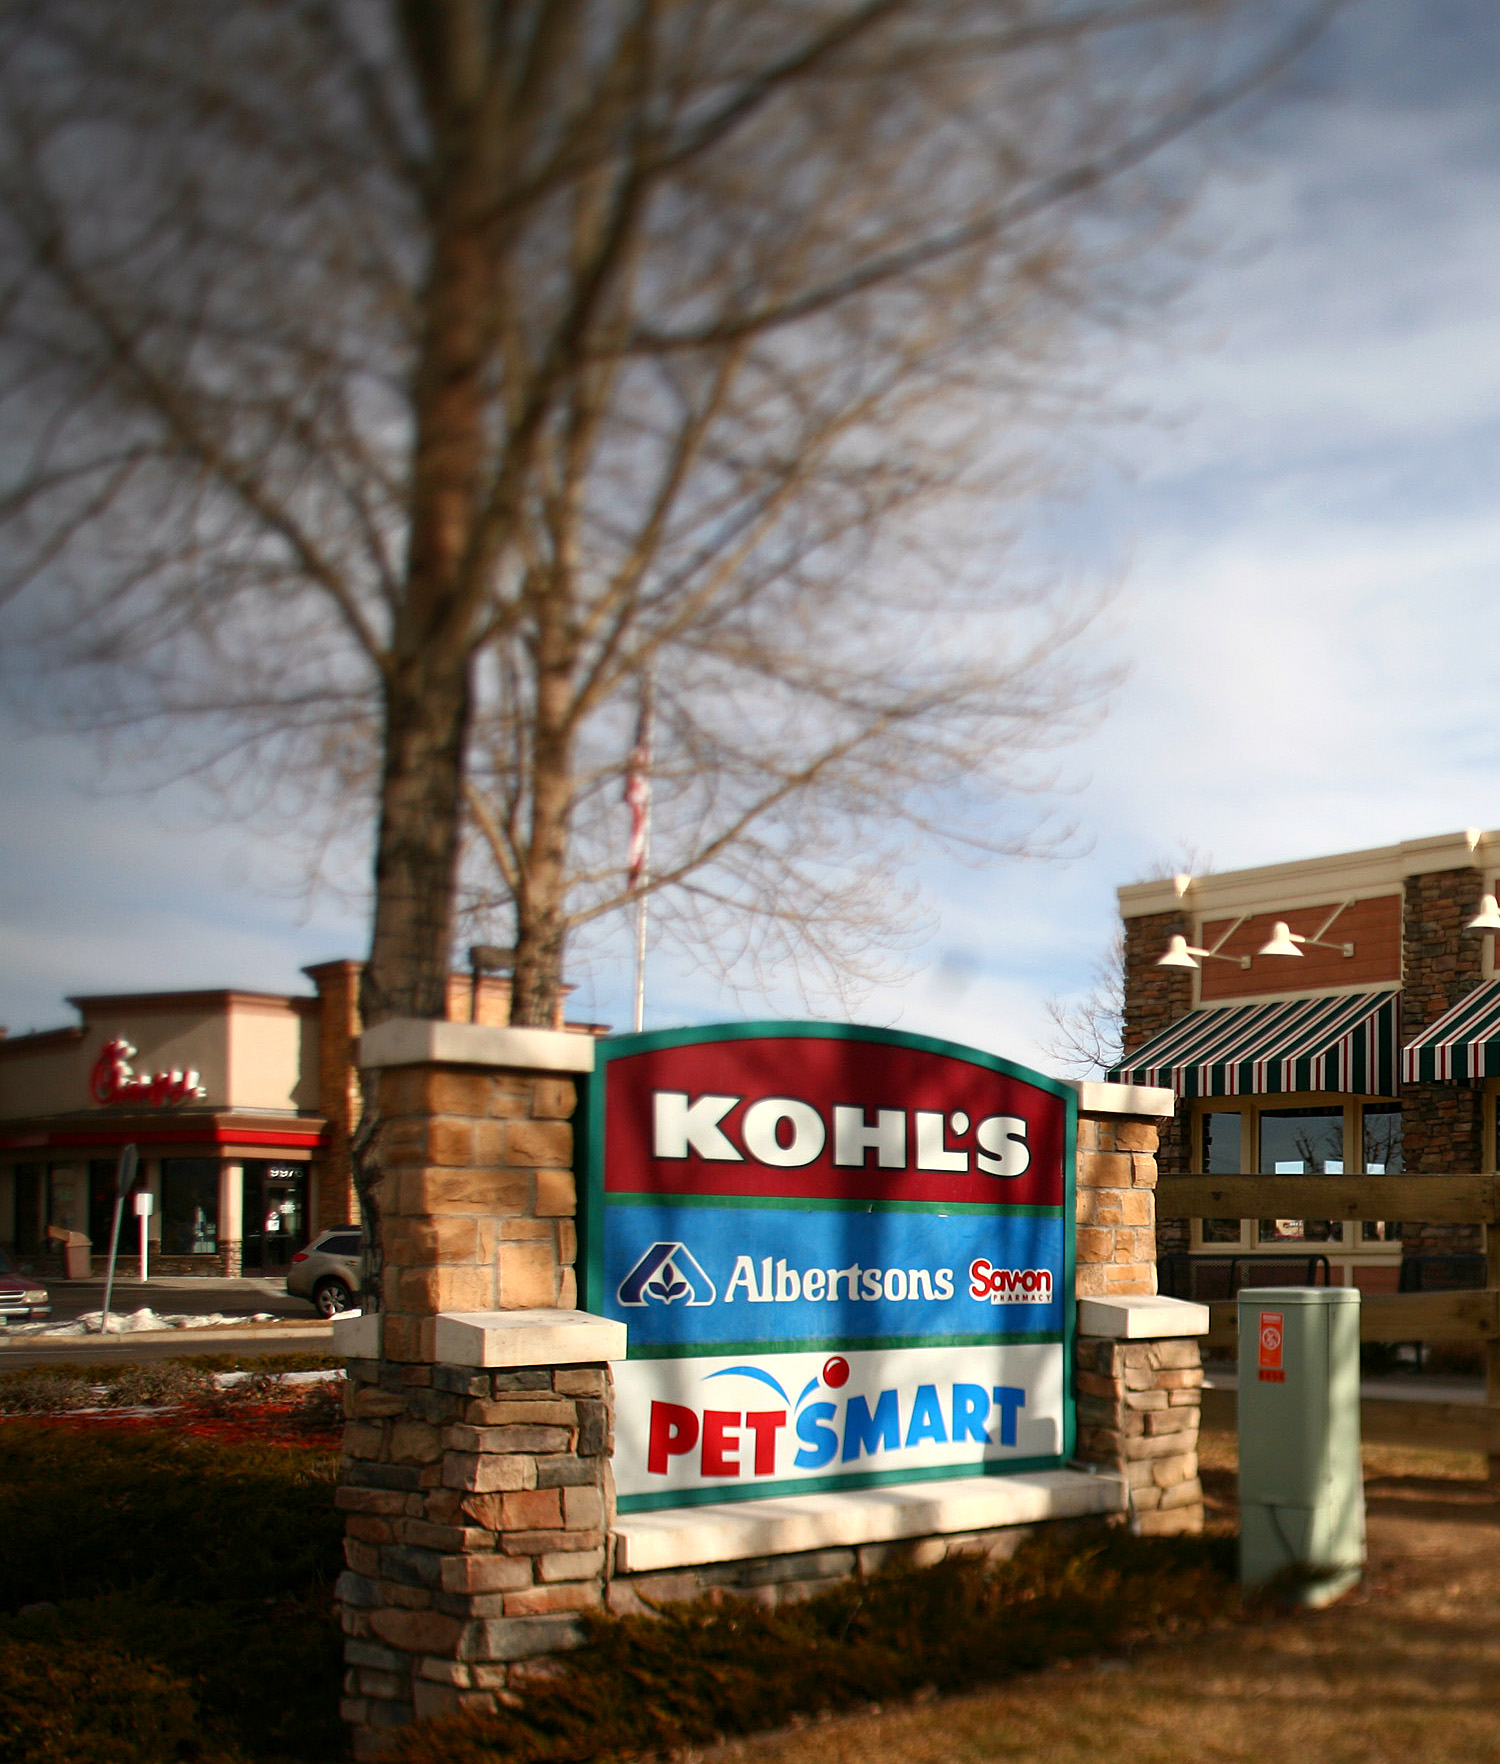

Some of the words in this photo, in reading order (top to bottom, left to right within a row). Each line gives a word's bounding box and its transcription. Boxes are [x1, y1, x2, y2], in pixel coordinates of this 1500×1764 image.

[652, 1090, 1031, 1178] KOHL'S
[723, 1254, 955, 1303] Albertsons
[993, 1294, 1052, 1302] PHARMACY
